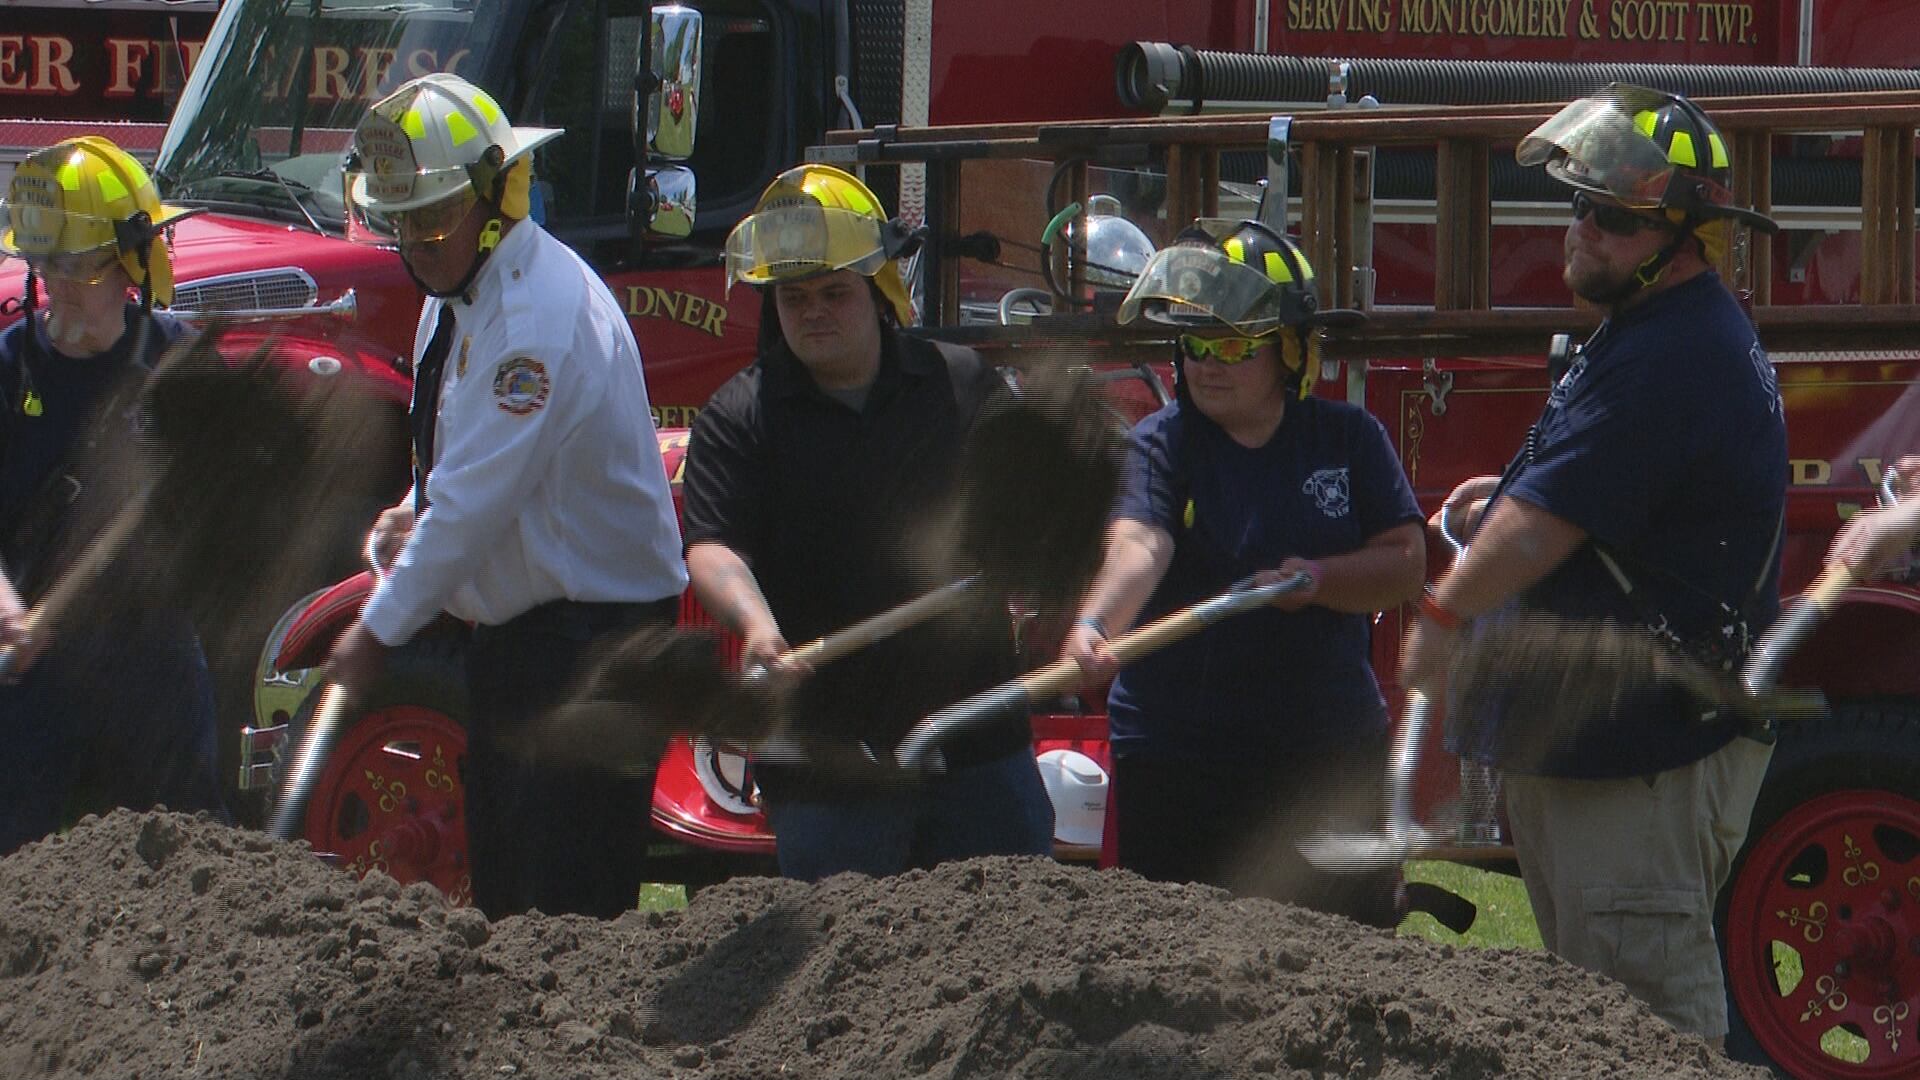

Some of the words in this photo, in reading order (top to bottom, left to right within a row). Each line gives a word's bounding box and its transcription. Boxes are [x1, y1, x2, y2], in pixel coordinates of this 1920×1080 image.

[1287, 0, 1391, 32] SERVING
[1399, 0, 1570, 38] MONTGOMERY
[1579, 0, 1600, 39] &
[1610, 0, 1689, 41] SCOTT
[1696, 3, 1758, 44] TWP.
[0, 35, 81, 93] ER
[627, 285, 728, 337] DNER
